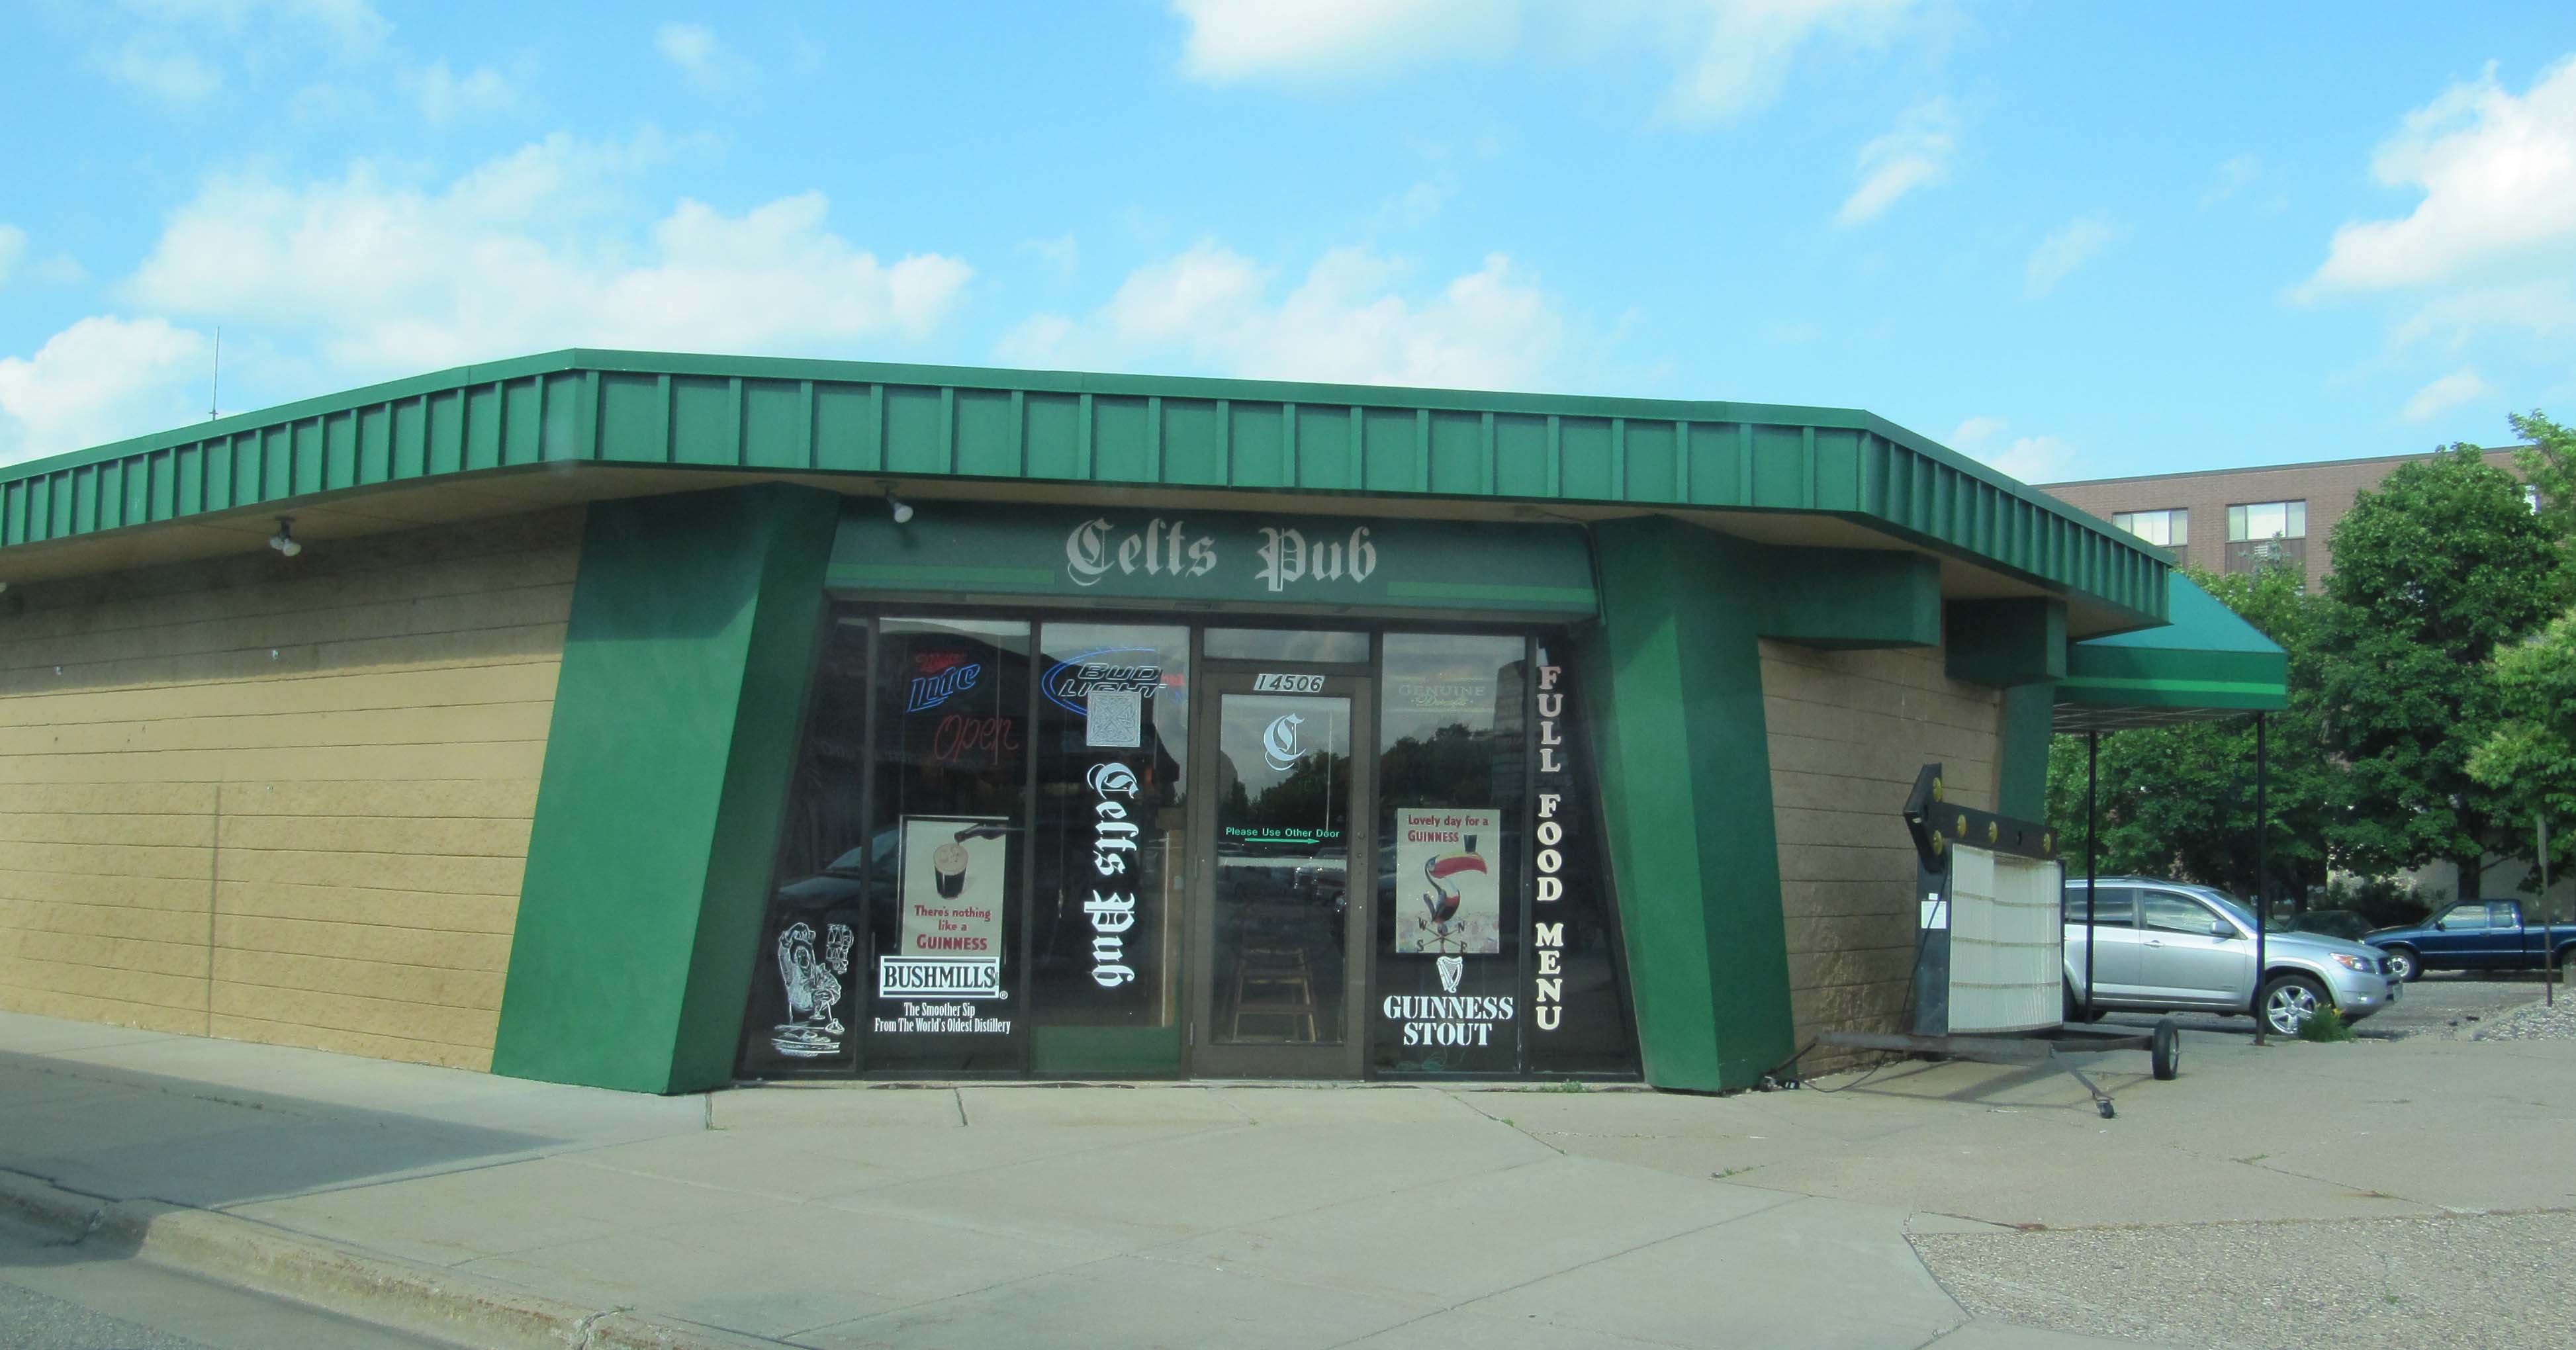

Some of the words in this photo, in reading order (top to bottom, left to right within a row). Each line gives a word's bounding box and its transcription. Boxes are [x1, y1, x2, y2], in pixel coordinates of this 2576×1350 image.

[1067, 518, 1217, 586] Celts
[1254, 525, 1377, 592] Pub
[1258, 675, 1322, 691] 14506
[1537, 666, 1563, 772] FULL
[934, 715, 1019, 763] Open
[1086, 762, 1139, 877] Celts
[1408, 814, 1441, 827] Lovely
[1444, 815, 1461, 828] day
[1465, 815, 1480, 827] for
[1226, 827, 1258, 836] Please
[1262, 828, 1281, 837] Use
[1285, 828, 1312, 838] Other
[1316, 829, 1340, 838] Door
[1408, 830, 1459, 842] GUINNESS
[1536, 793, 1563, 901] FOOD
[915, 905, 950, 917] There's
[952, 906, 991, 922] nothing
[938, 919, 958, 931] like
[916, 934, 988, 951] GUINNESS
[1083, 889, 1135, 987] Pub
[883, 966, 996, 989] BUSHMILLS
[1535, 922, 1564, 1030] MENU
[903, 1002, 920, 1016] The
[922, 1002, 961, 1017] Smoother
[962, 1003, 976, 1019] Sip
[1383, 995, 1514, 1020] GUINNESS
[874, 1018, 897, 1032] From
[897, 1018, 915, 1032] The
[915, 1018, 946, 1032] World's
[947, 1018, 973, 1032] Oldest
[974, 1018, 1011, 1034] Distillery
[1403, 1022, 1493, 1046] STOUT
